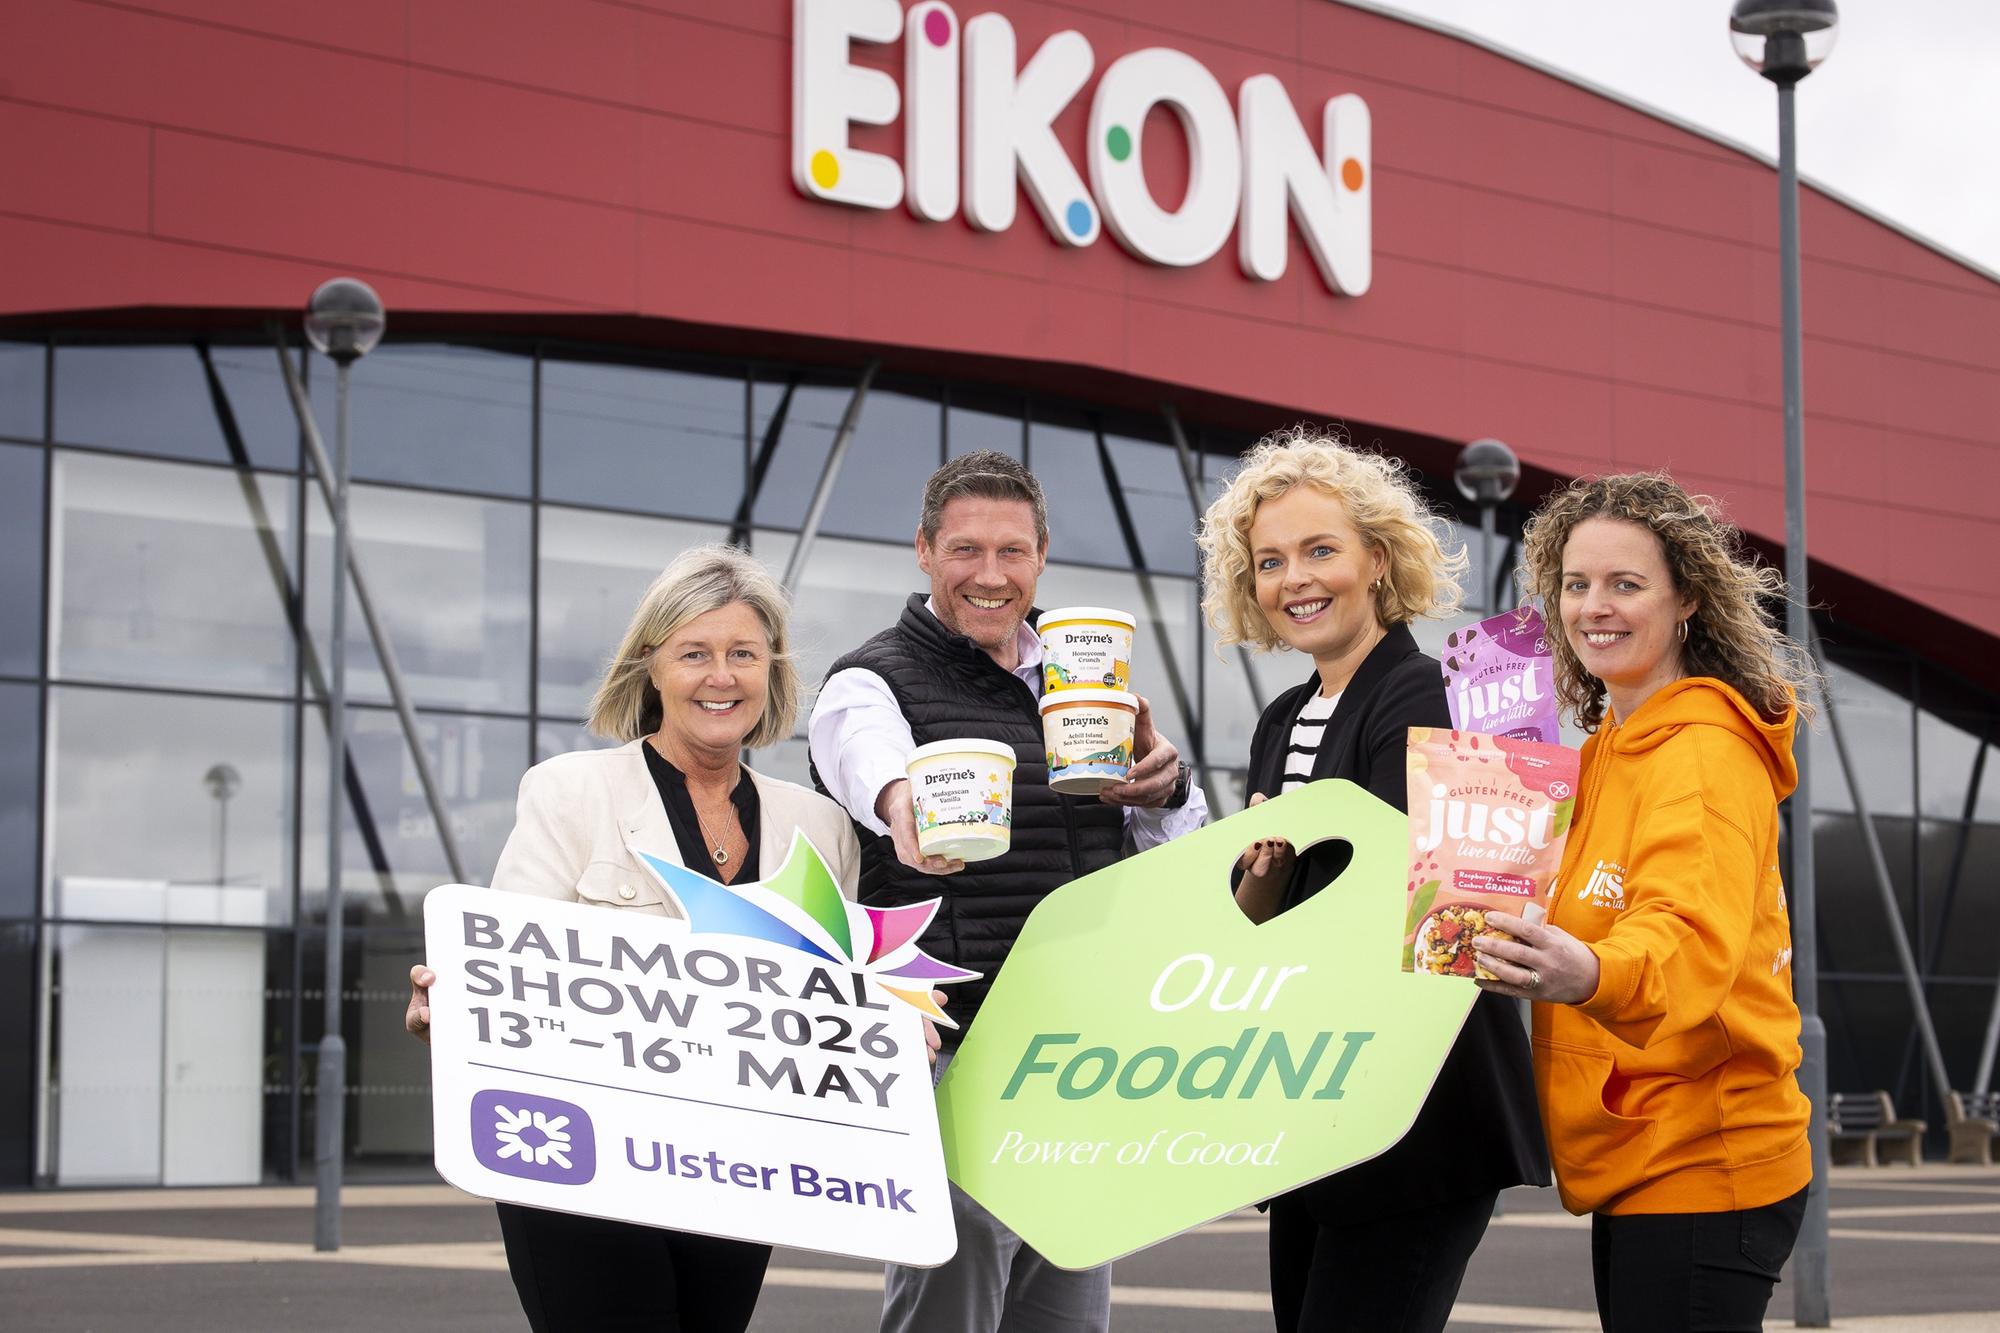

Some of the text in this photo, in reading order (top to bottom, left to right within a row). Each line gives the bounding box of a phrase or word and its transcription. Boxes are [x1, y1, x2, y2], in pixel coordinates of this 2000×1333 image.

[792, 0, 1372, 296] EIKON
[1065, 634, 1113, 645] Drayne's
[1470, 662, 1527, 685] GLUTEN FREE
[1458, 659, 1545, 732] just
[1062, 716, 1109, 727] Drayne's
[1481, 715, 1498, 732] live
[1507, 702, 1537, 723] little
[925, 769, 975, 785] Drayne's
[931, 789, 970, 799] Madagascan
[1450, 786, 1535, 808] GLUTEN FREE
[1415, 783, 1558, 852] just
[1457, 840, 1537, 866] live a little
[1458, 881, 1530, 896] Cashew GRANOLA
[1459, 871, 1495, 882] Raspberry,
[1497, 875, 1523, 886] Coconut
[1578, 859, 1624, 900] jus
[463, 911, 889, 1011] BALMORAL
[1149, 953, 1308, 1013] Our
[464, 959, 899, 1059] SHOW 2026
[737, 1050, 900, 1108] MAY
[1000, 1026, 1376, 1101] FoodNI
[991, 1130, 1287, 1167] Power of Good.
[624, 1137, 918, 1214] Ulster Bank
